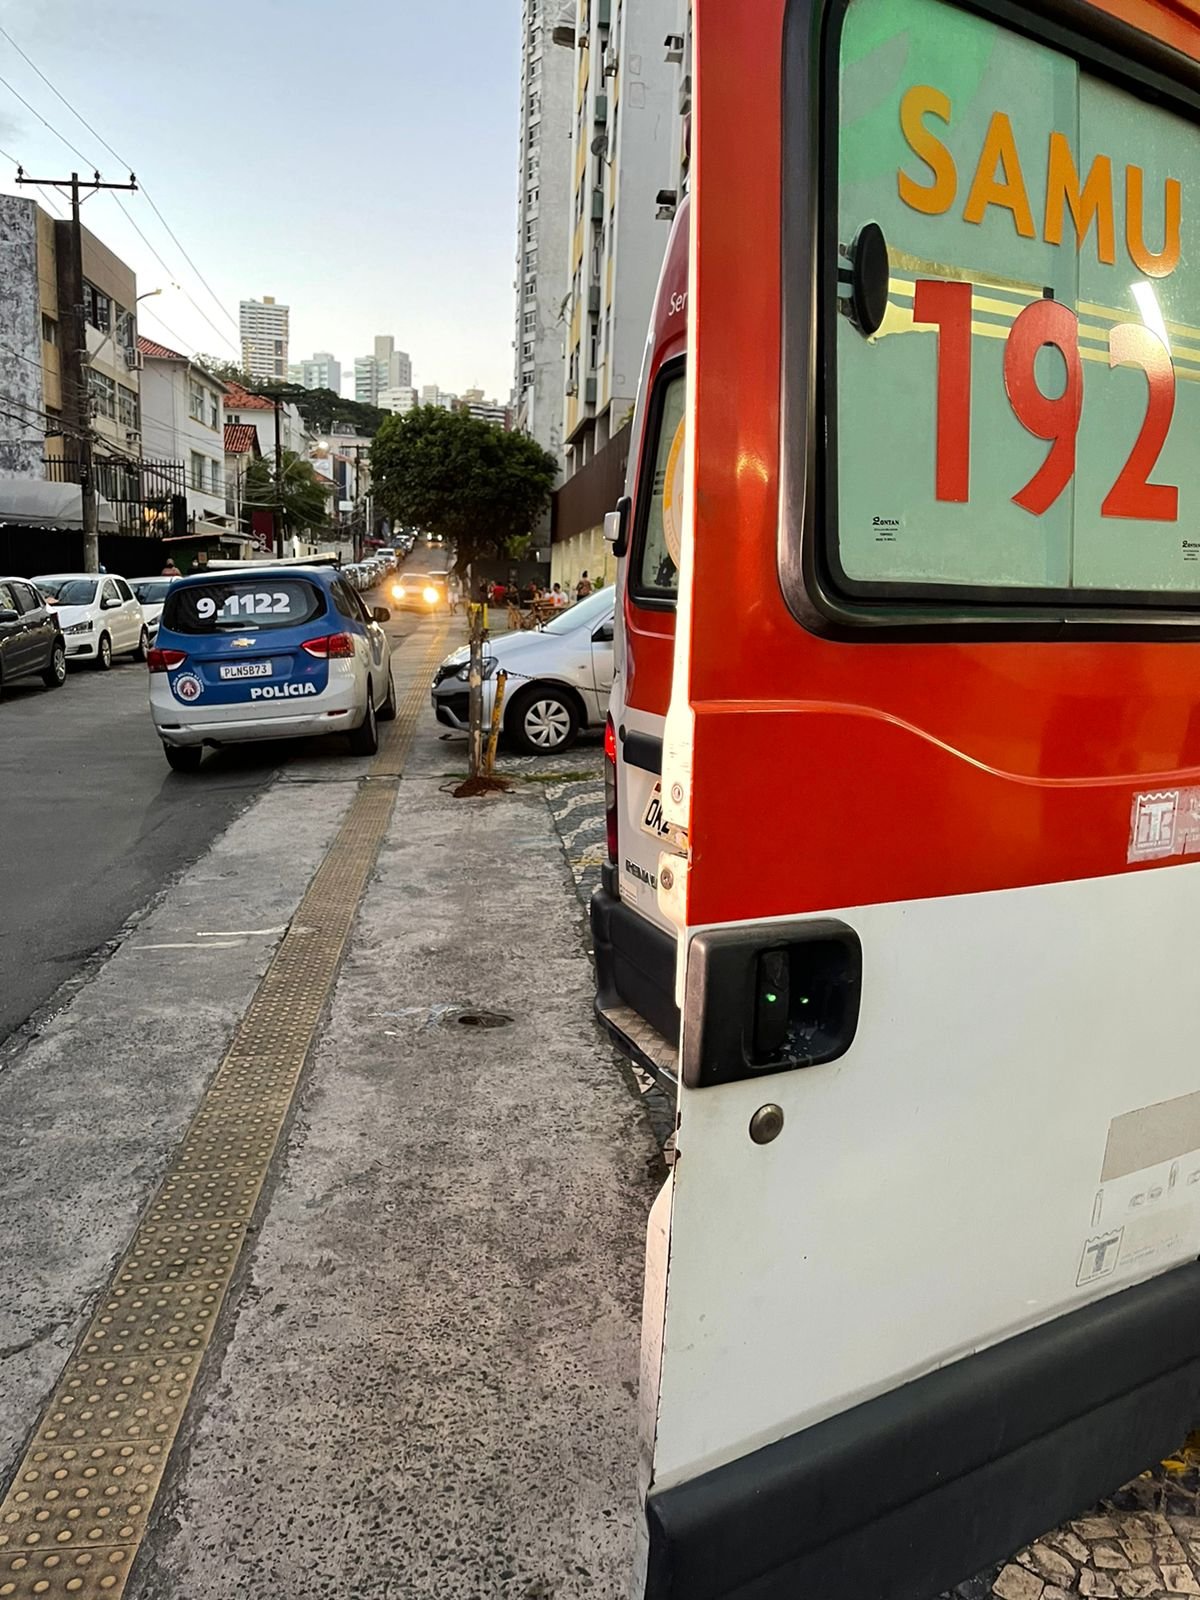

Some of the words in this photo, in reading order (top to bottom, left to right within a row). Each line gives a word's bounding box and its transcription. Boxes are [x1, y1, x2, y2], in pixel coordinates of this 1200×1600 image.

[899, 85, 1182, 278] SAMU
[913, 280, 1179, 521] 192
[197, 593, 290, 619] 9.1122
[223, 665, 267, 678] PLN5B73
[250, 681, 316, 699] POLÍCIA
